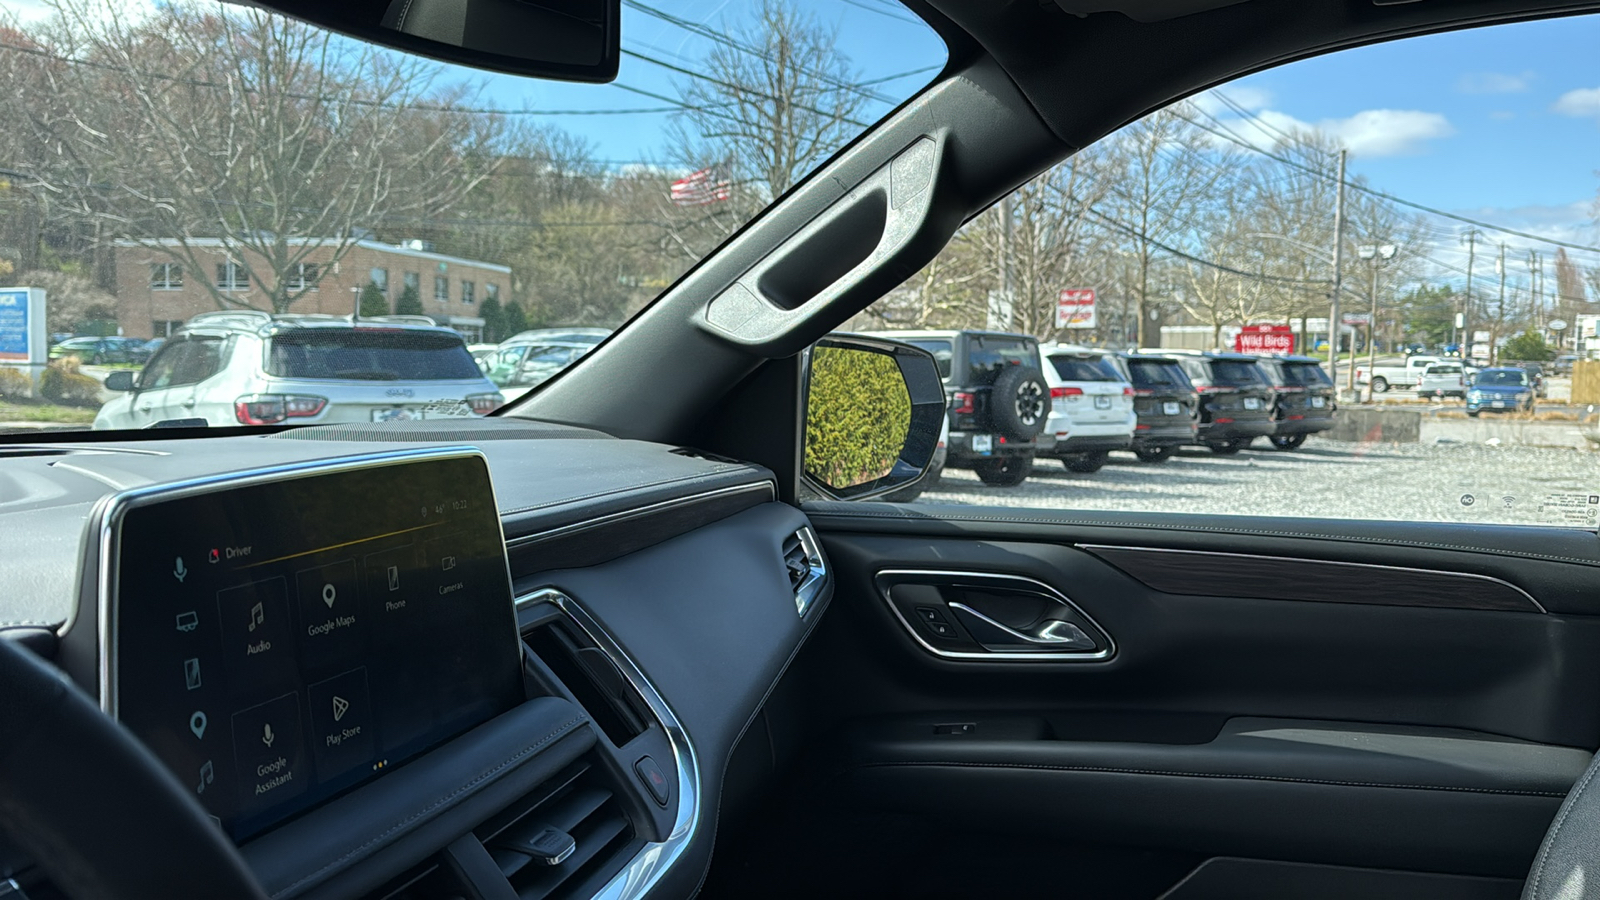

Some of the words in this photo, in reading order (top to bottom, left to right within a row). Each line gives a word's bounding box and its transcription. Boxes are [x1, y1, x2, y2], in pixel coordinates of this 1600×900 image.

[1240, 334, 1263, 347] Wild
[1264, 334, 1291, 347] Birds
[225, 545, 252, 559] Driver
[438, 581, 464, 595] Cameras
[385, 599, 406, 612] Phone
[308, 619, 335, 636] Google
[335, 614, 356, 628] Maps
[247, 640, 271, 655] Audio
[326, 733, 341, 747] Play
[342, 726, 361, 740] Store
[257, 756, 287, 777] Google
[255, 771, 293, 796] Assistant
